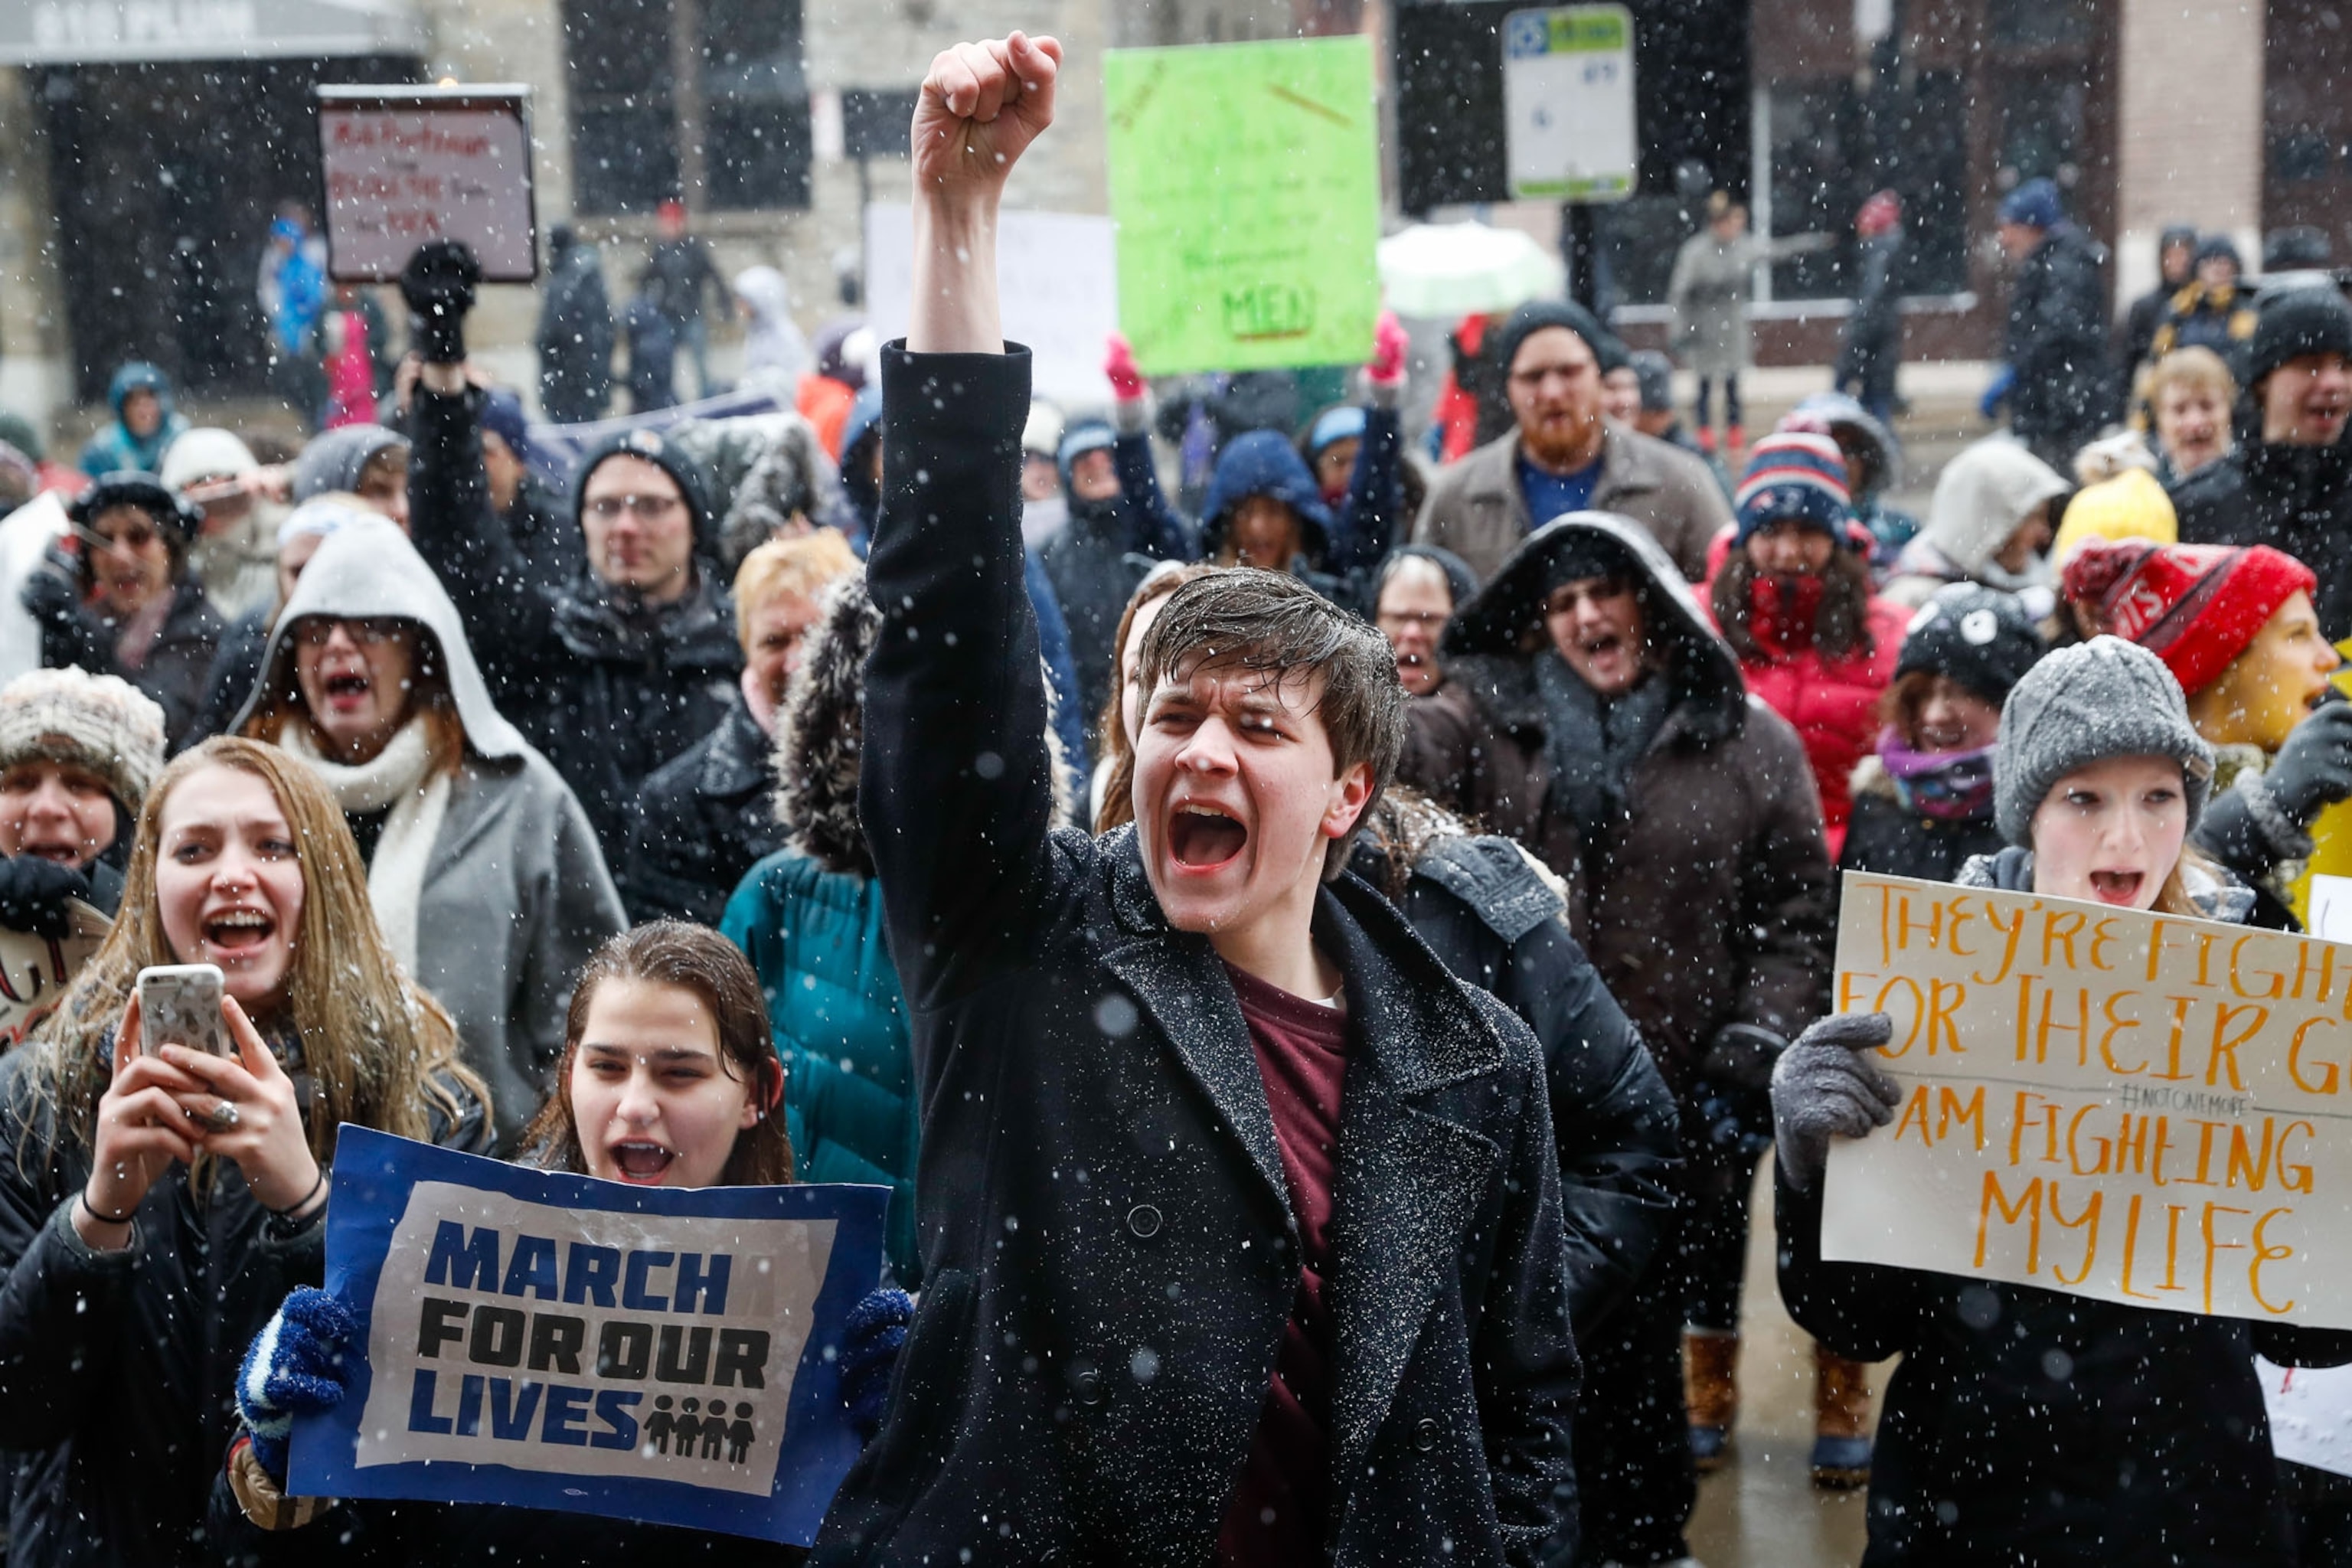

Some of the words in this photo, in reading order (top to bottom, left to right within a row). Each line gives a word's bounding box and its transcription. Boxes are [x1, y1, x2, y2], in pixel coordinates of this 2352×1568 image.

[1855, 883, 2122, 985] THEY'RE
[2016, 973, 2270, 1092] THEIR
[2287, 1016, 2352, 1096] G
[1895, 1084, 1986, 1152] AM
[423, 1220, 733, 1315] MARCH
[1973, 1170, 2103, 1285] MY
[2122, 1194, 2295, 1316] LIFE
[416, 1297, 586, 1375] FOR
[596, 1320, 771, 1389] OUR
[407, 1368, 643, 1452] LIVES
